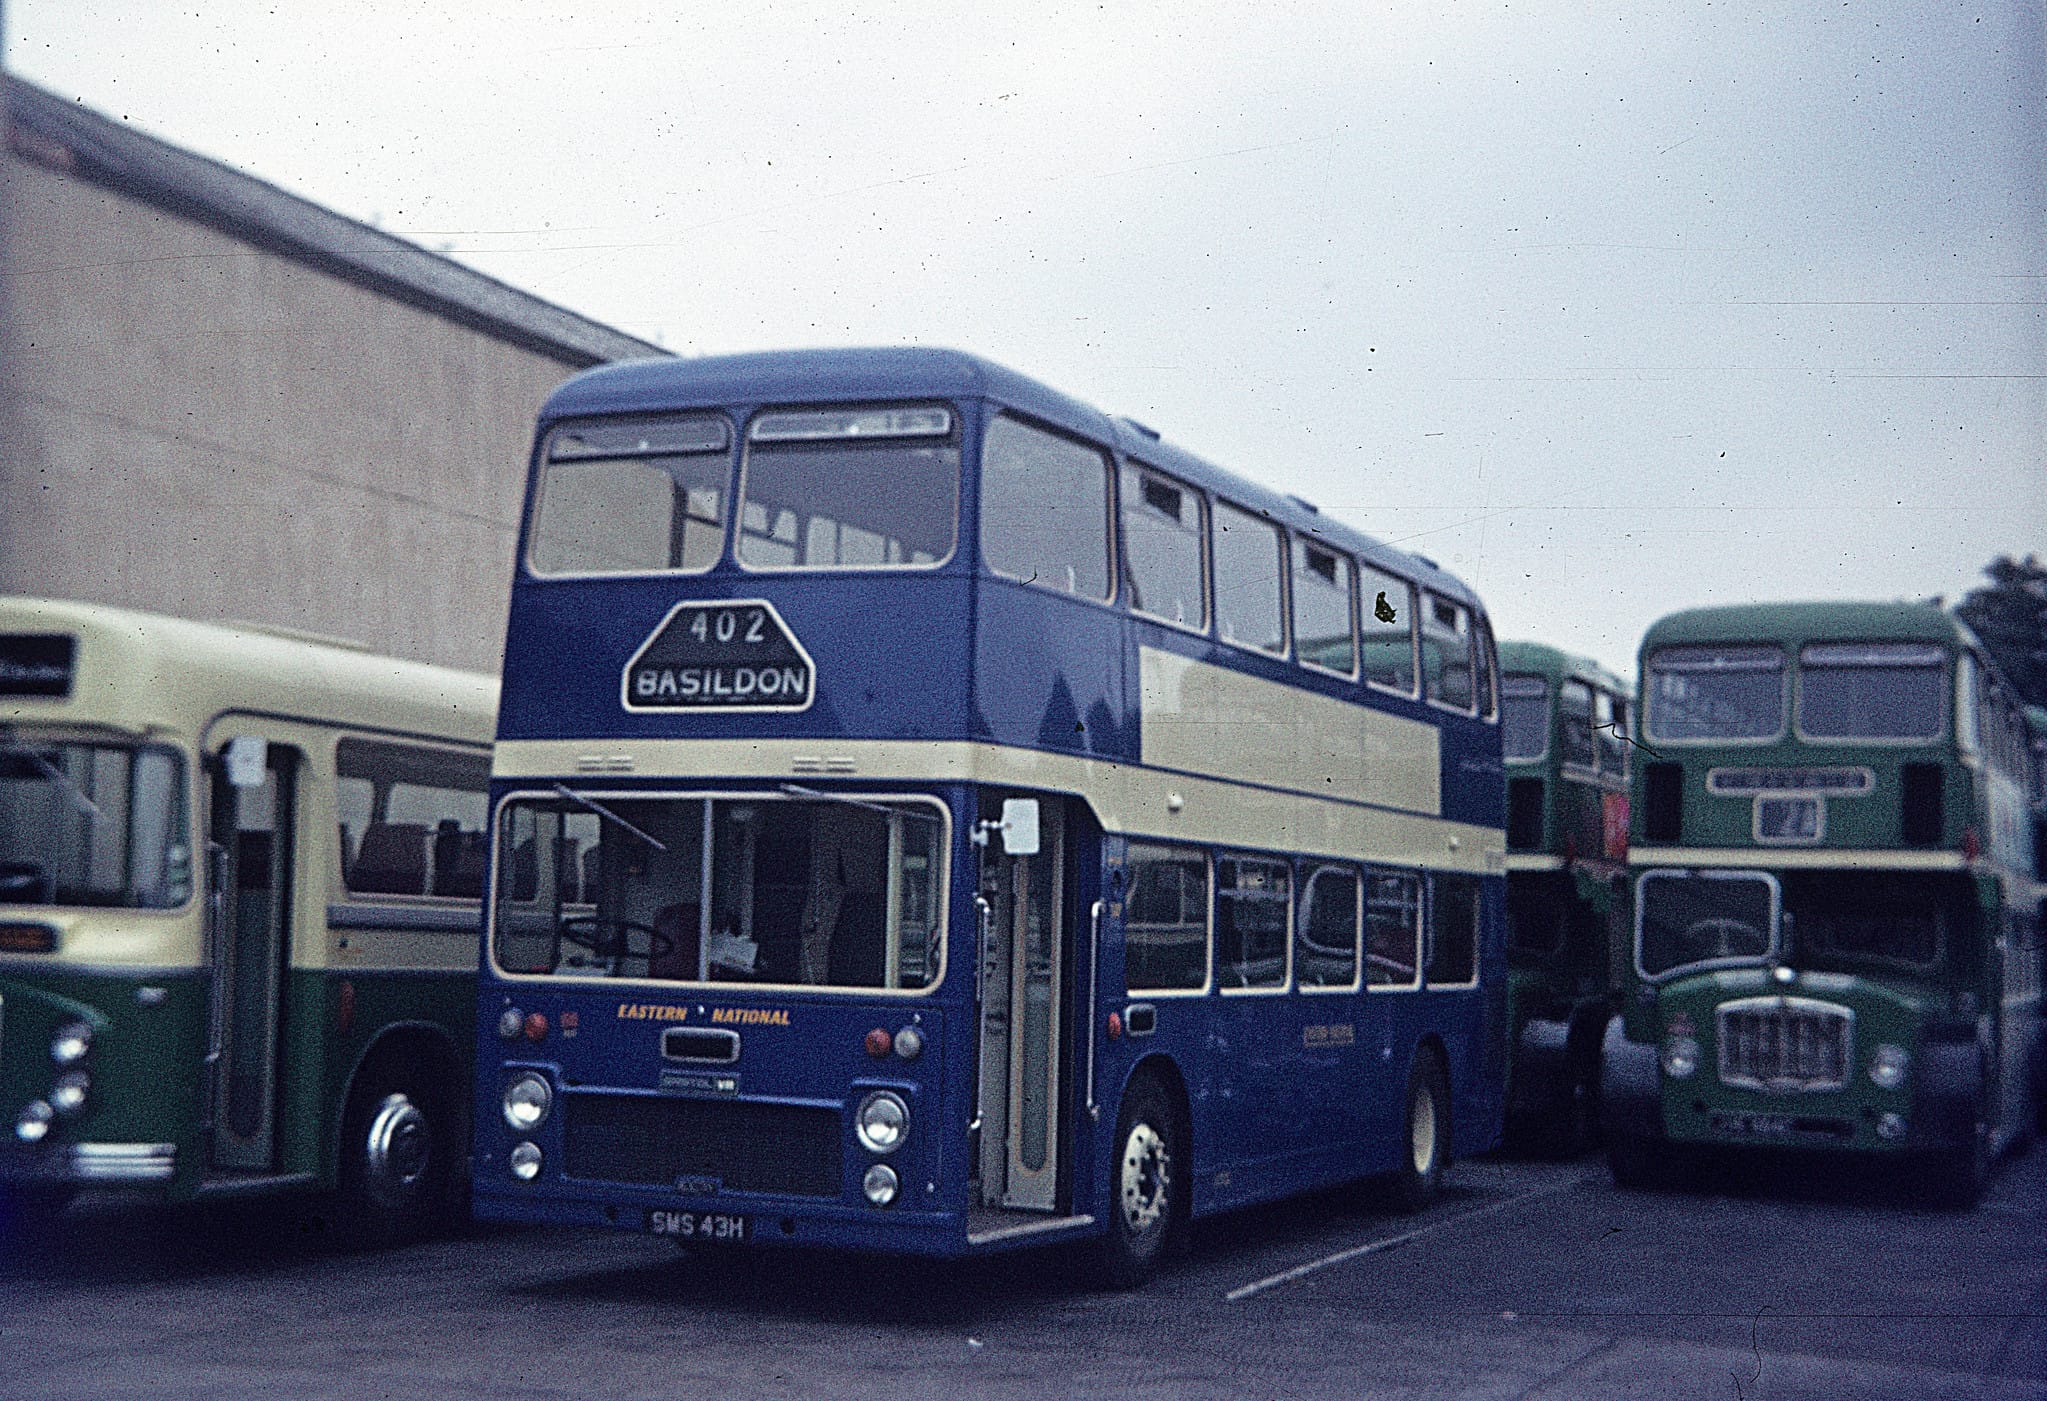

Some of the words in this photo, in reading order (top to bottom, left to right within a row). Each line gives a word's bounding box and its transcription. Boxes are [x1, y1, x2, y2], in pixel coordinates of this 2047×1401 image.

[690, 610, 767, 643] 402
[637, 667, 806, 696] BASILDON
[617, 1004, 688, 1021] EASTERN
[712, 1008, 791, 1026] NATIONAL
[700, 1215, 744, 1238] 43H
